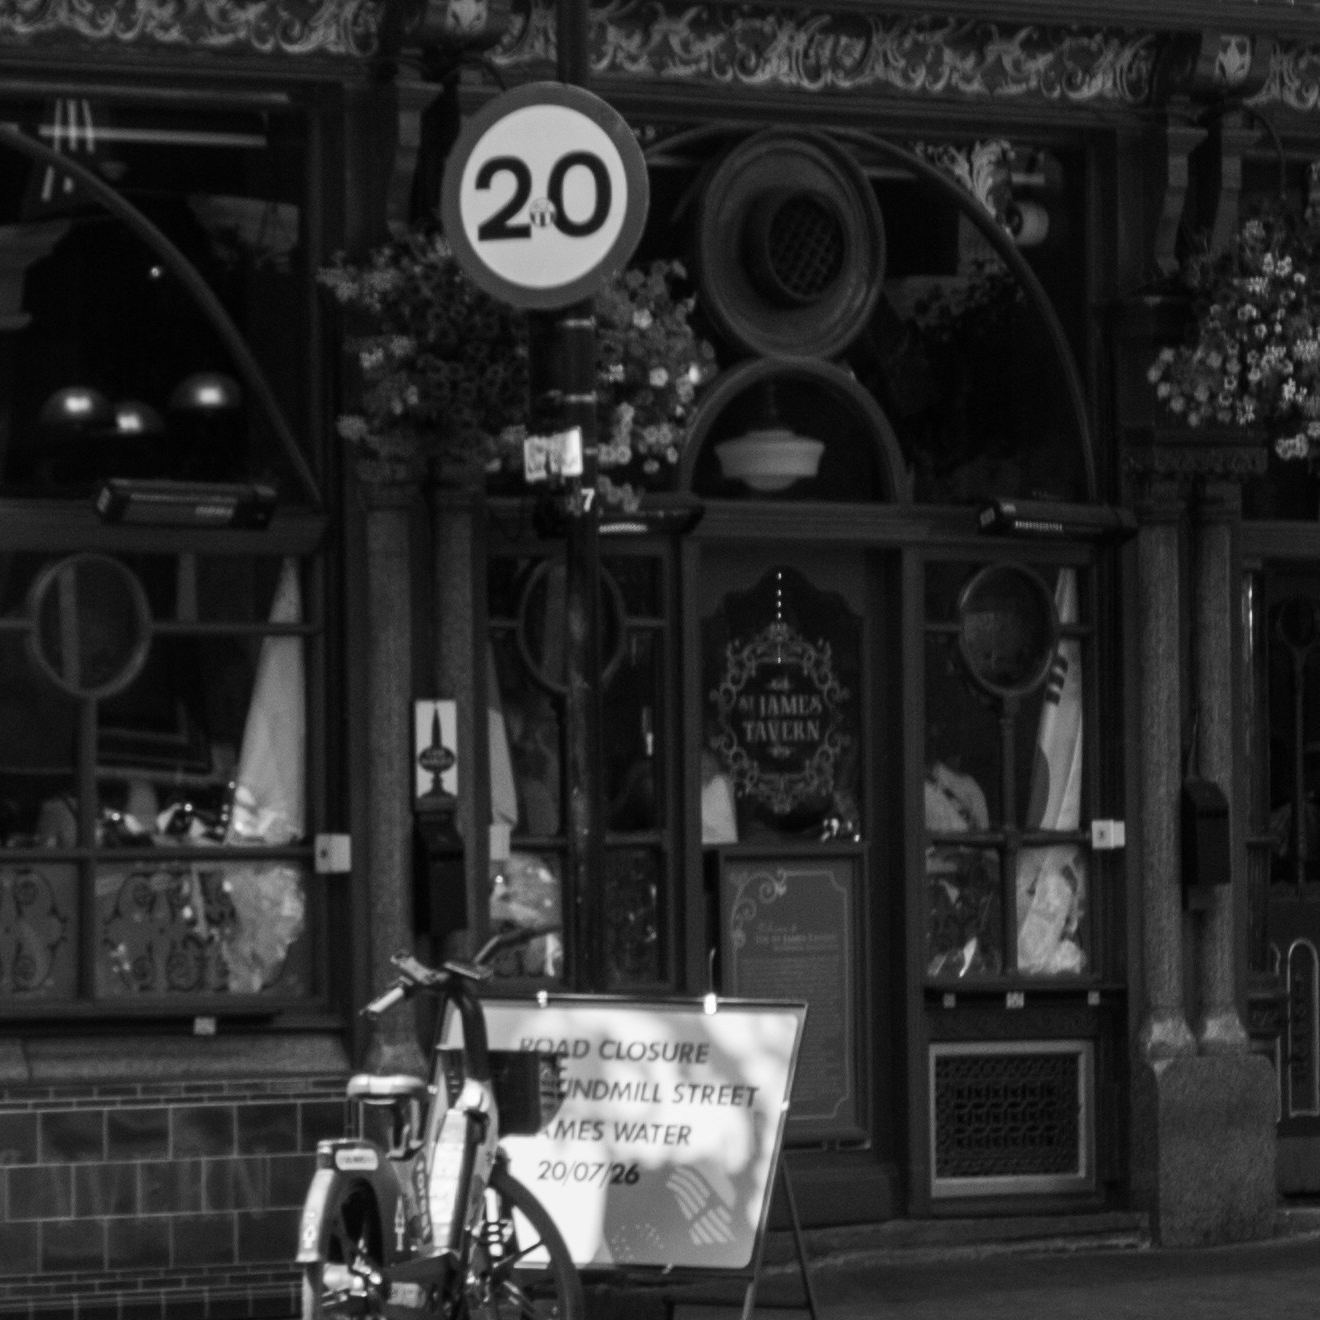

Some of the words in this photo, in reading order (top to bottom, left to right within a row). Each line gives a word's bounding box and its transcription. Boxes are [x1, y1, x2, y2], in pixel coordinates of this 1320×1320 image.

[474, 149, 613, 242] 20
[580, 487, 596, 513] 7
[759, 694, 823, 717] JAMES
[741, 720, 821, 742] TAVERN
[598, 1038, 711, 1064] CLOSURE
[671, 1082, 761, 1109] STREET
[613, 1121, 693, 1147] WATER
[536, 1159, 641, 1188] 20/07/26
